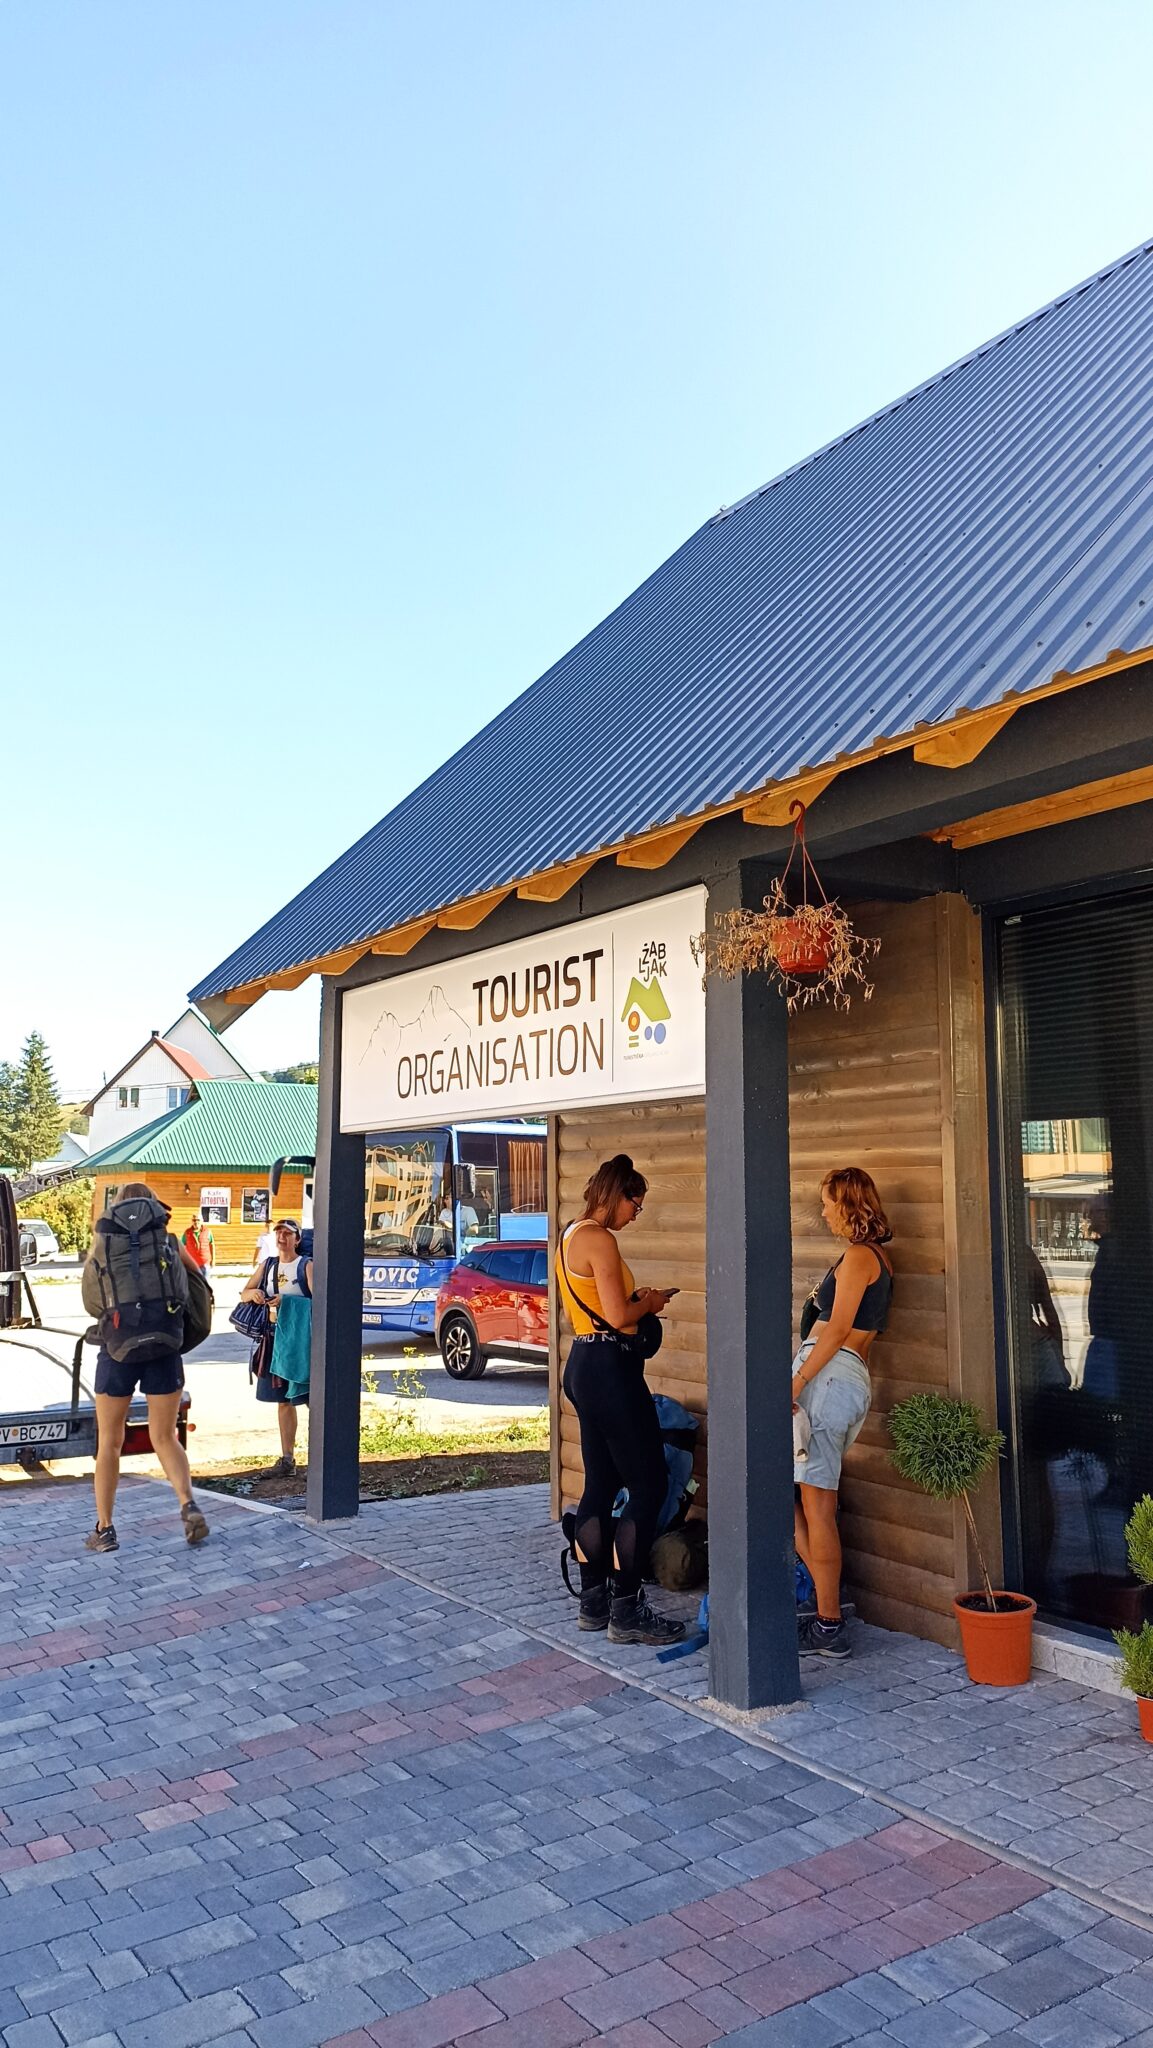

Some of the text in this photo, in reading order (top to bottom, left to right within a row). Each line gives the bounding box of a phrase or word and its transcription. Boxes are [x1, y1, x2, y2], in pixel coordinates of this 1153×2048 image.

[472, 949, 604, 1026] TOURIST
[639, 957, 668, 982] LJAK
[397, 1018, 604, 1099] ORGANISATION
[0, 1424, 65, 1442] V BC747
